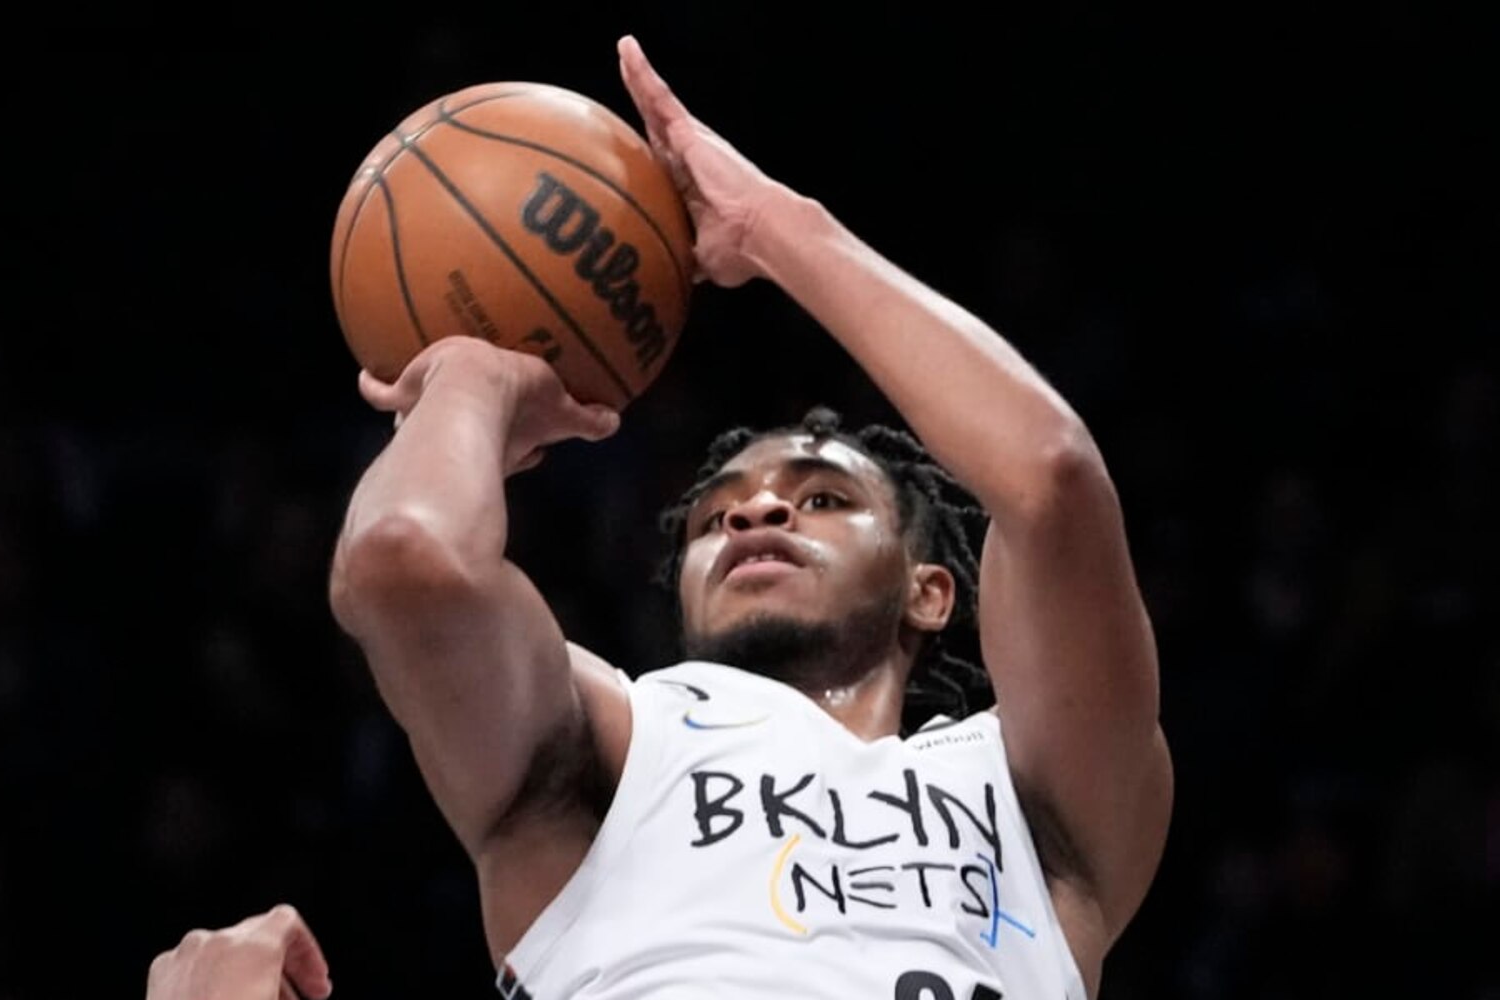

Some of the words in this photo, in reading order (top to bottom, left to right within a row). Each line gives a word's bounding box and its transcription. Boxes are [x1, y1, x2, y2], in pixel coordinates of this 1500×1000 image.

[521, 170, 668, 372] Wilson
[691, 768, 1003, 873] BKLYN
[791, 861, 992, 920] NETS
